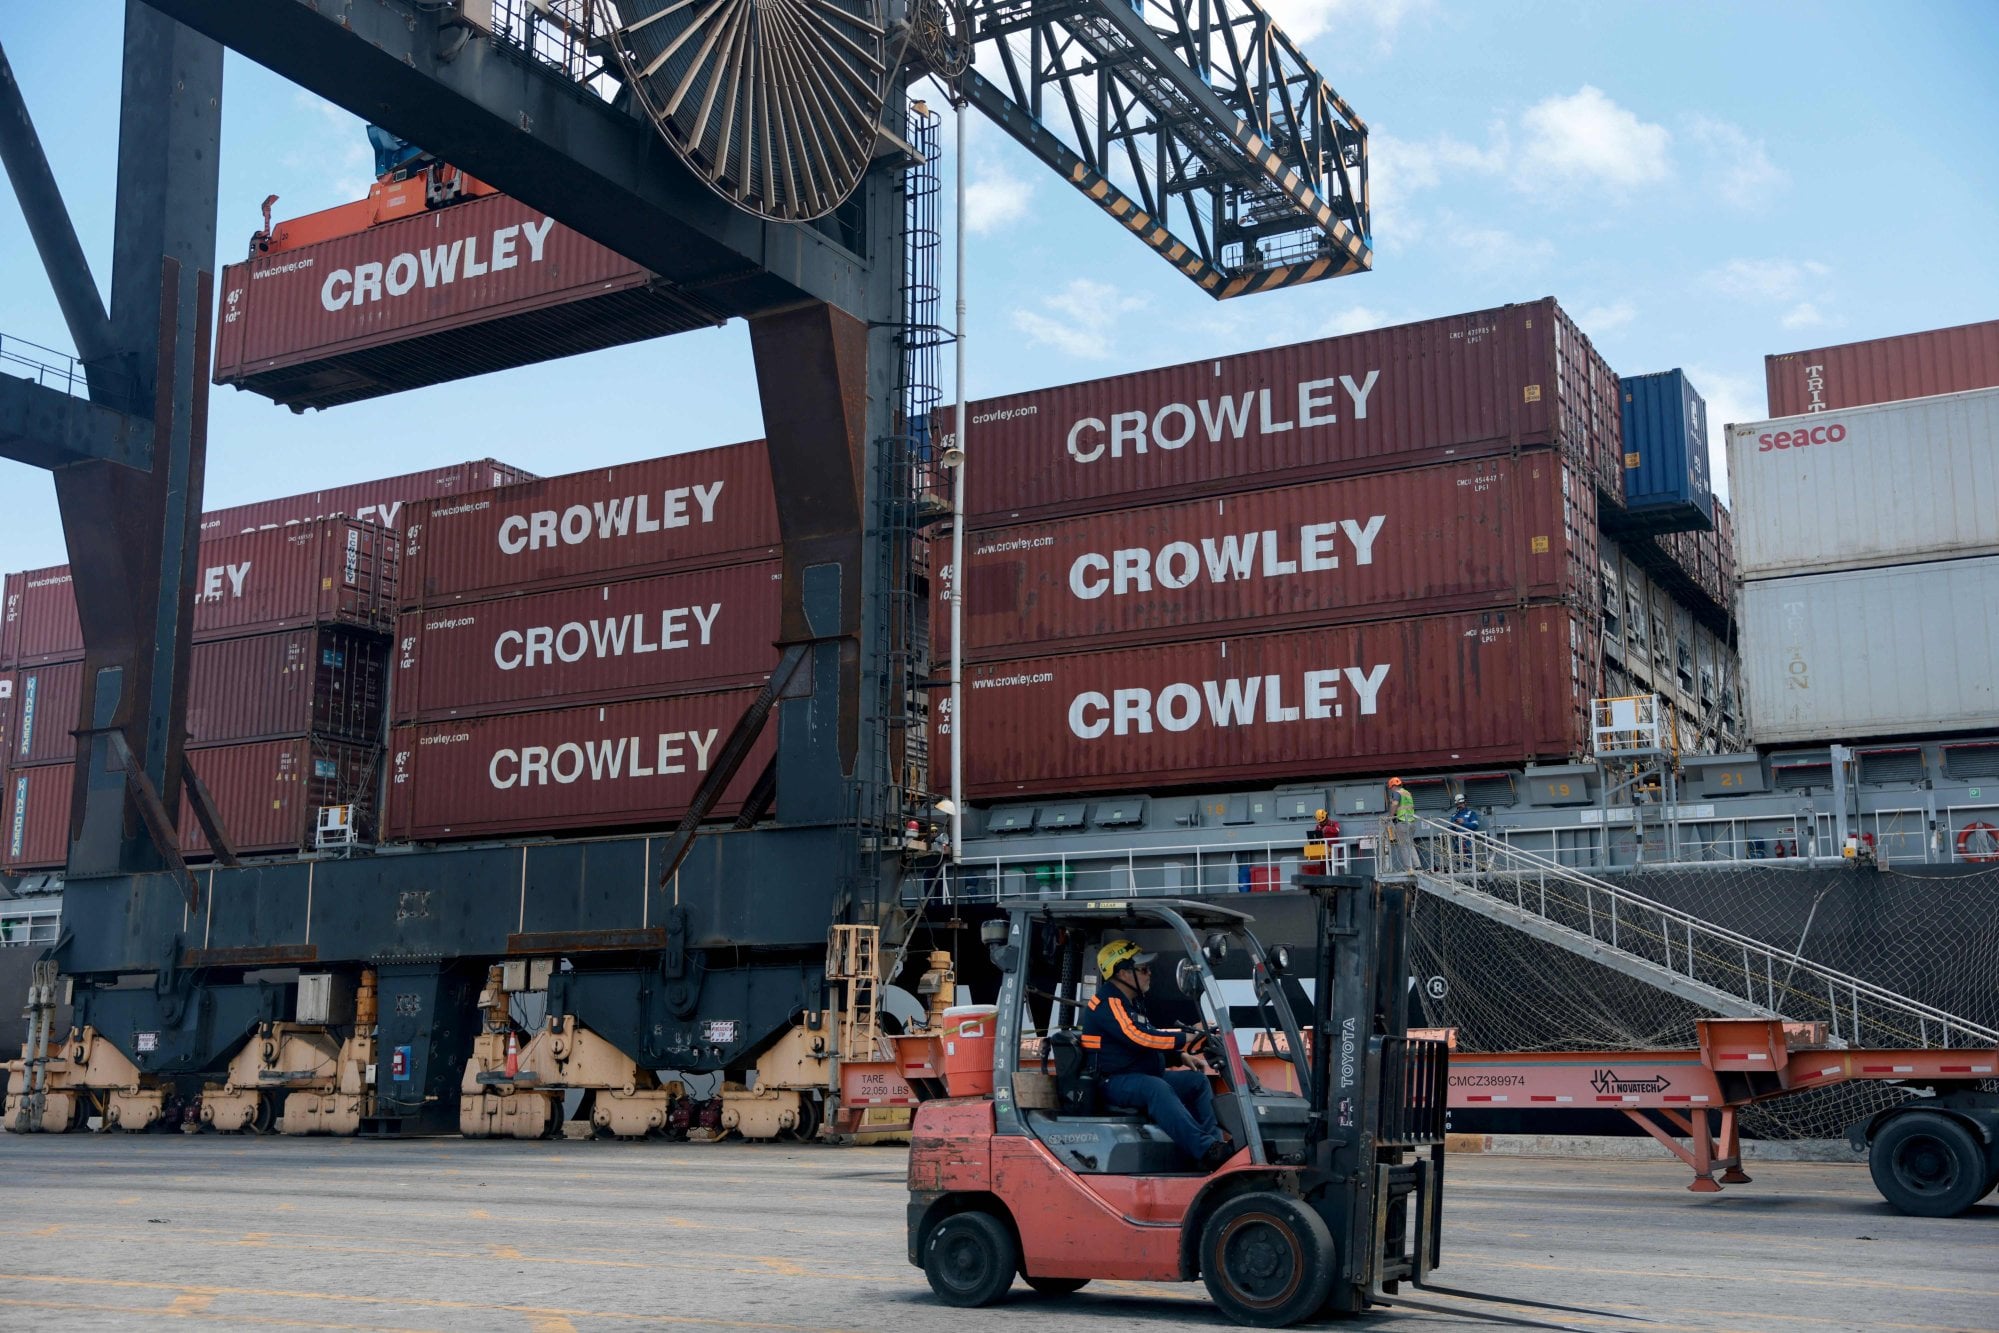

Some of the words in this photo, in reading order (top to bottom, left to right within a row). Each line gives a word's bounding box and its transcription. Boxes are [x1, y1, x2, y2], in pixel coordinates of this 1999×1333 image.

[321, 217, 555, 313] CROWLEY
[972, 405, 1038, 425] crowley.com
[1067, 370, 1380, 464] CROWLEY
[1758, 424, 1846, 452] seaco
[498, 481, 724, 555] CROWLEY
[1069, 515, 1386, 600] CROWLEY
[195, 561, 251, 604] EY
[426, 616, 475, 631] crowley.com
[494, 603, 722, 671] CROWLEY
[972, 671, 1053, 689] www.crowley.com
[1068, 664, 1391, 739] CROWLEY
[420, 732, 470, 746] crowley.com
[489, 728, 719, 789] CROWLEY
[1719, 772, 1744, 787] 21
[1549, 784, 1571, 798] 19
[1341, 1018, 1355, 1088] TOYOTA
[861, 1074, 885, 1084] TARE
[1448, 1075, 1526, 1087] CMCZ389974
[1616, 1083, 1657, 1093] NOVATECH
[861, 1086, 888, 1096] 22,050
[892, 1085, 909, 1095] LBS
[1063, 1133, 1100, 1144] TOYOTA
